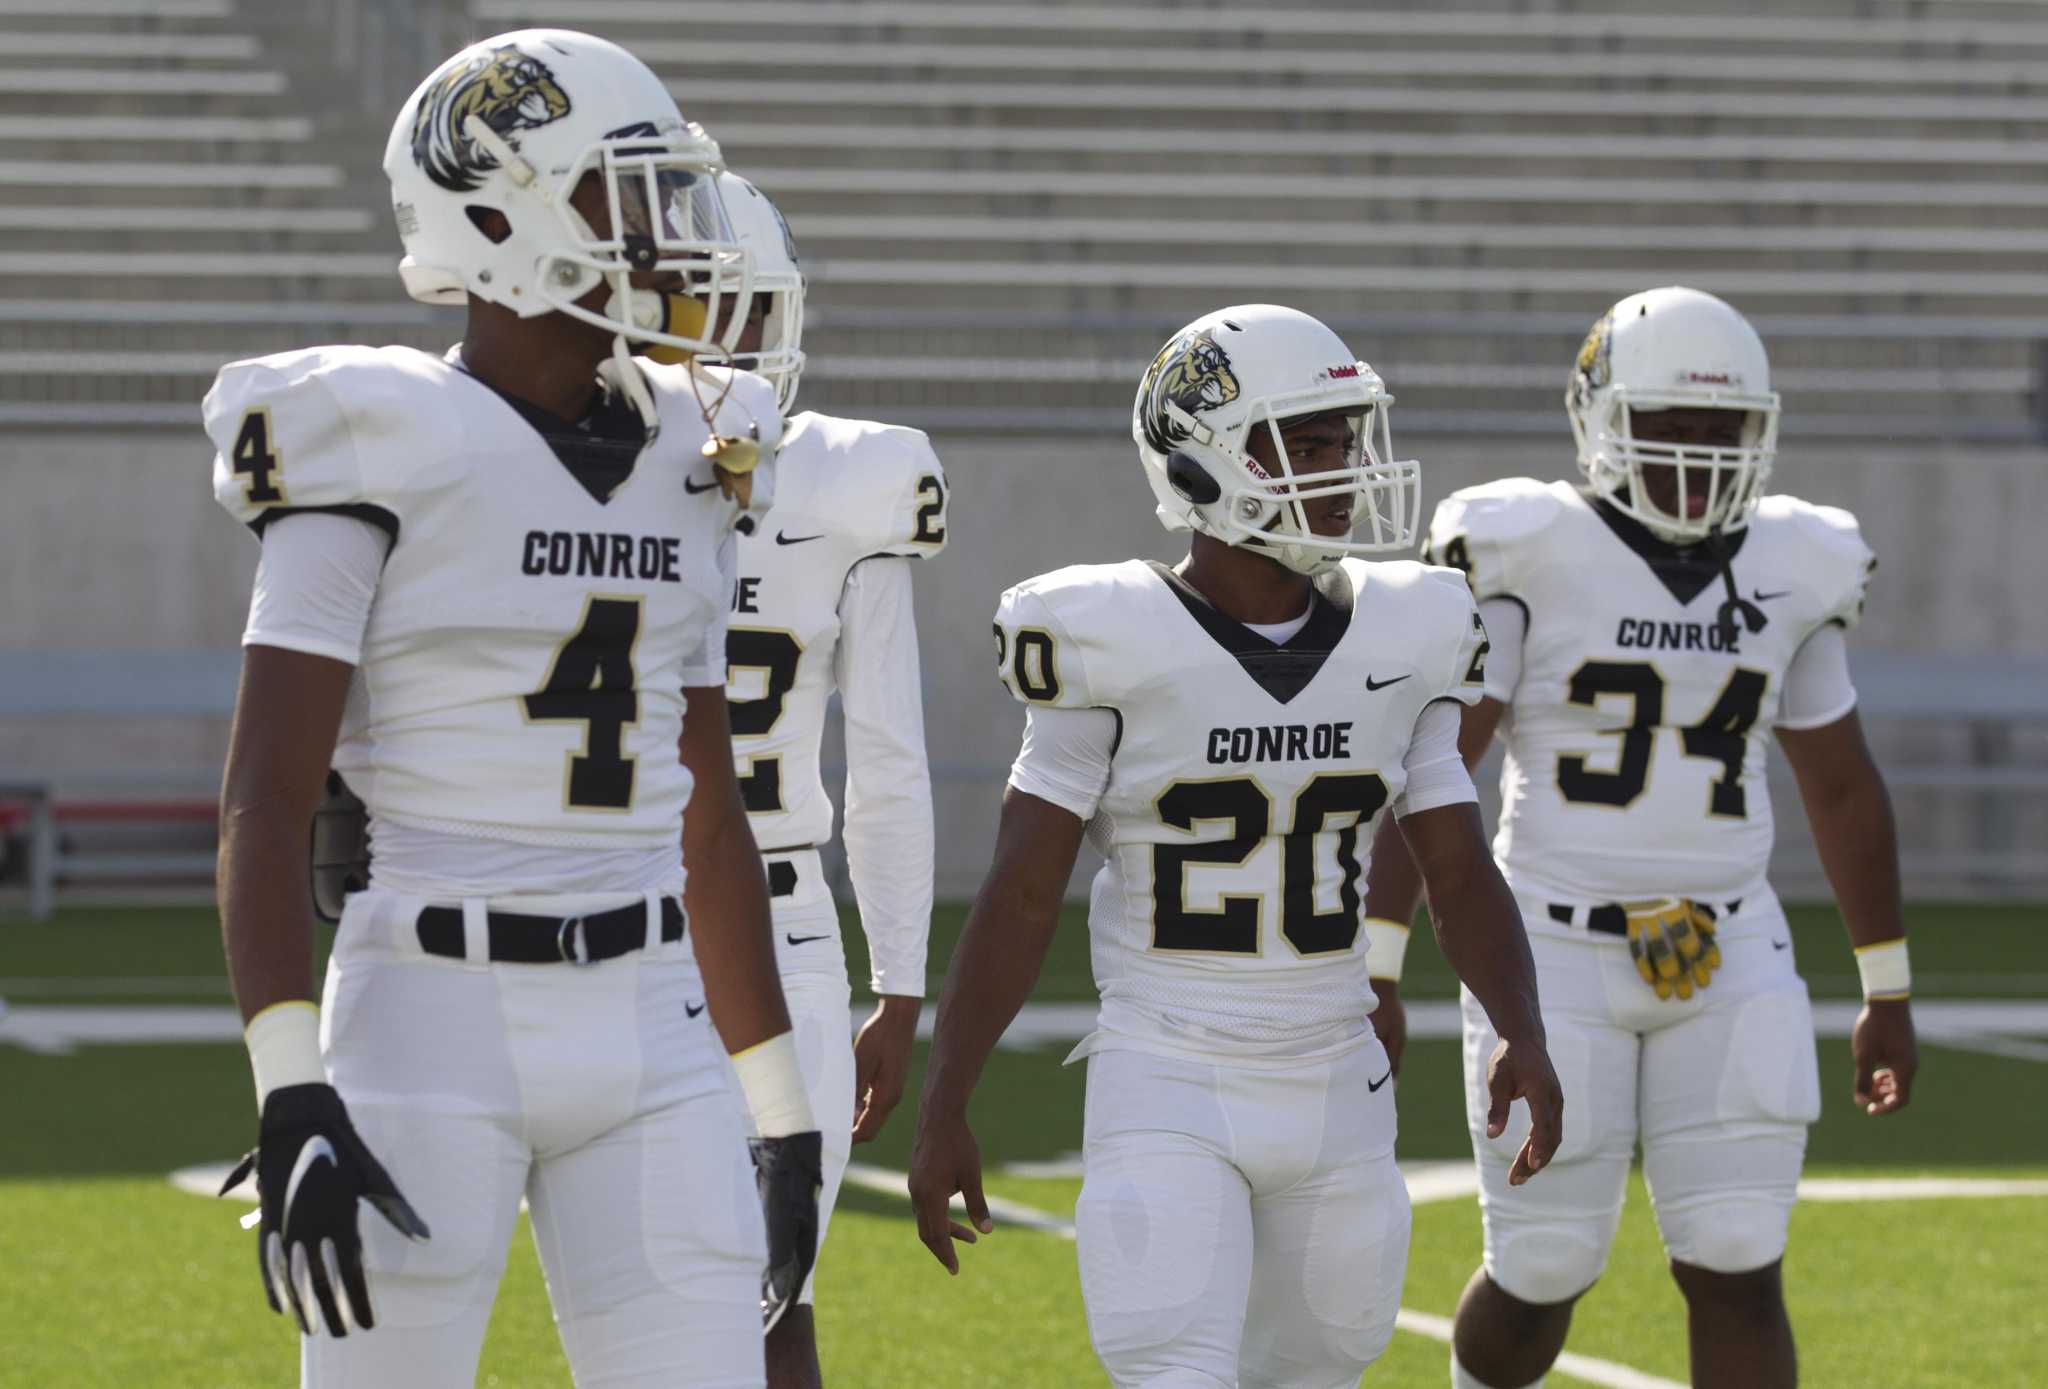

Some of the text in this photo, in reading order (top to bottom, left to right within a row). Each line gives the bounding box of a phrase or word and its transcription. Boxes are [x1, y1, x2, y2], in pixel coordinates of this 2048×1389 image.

[231, 405, 287, 507] 4
[522, 530, 681, 582] CONROE
[518, 592, 646, 814] 4
[1207, 721, 1353, 764] CONROE
[1553, 656, 1770, 821] 34
[1146, 768, 1390, 958] 20
